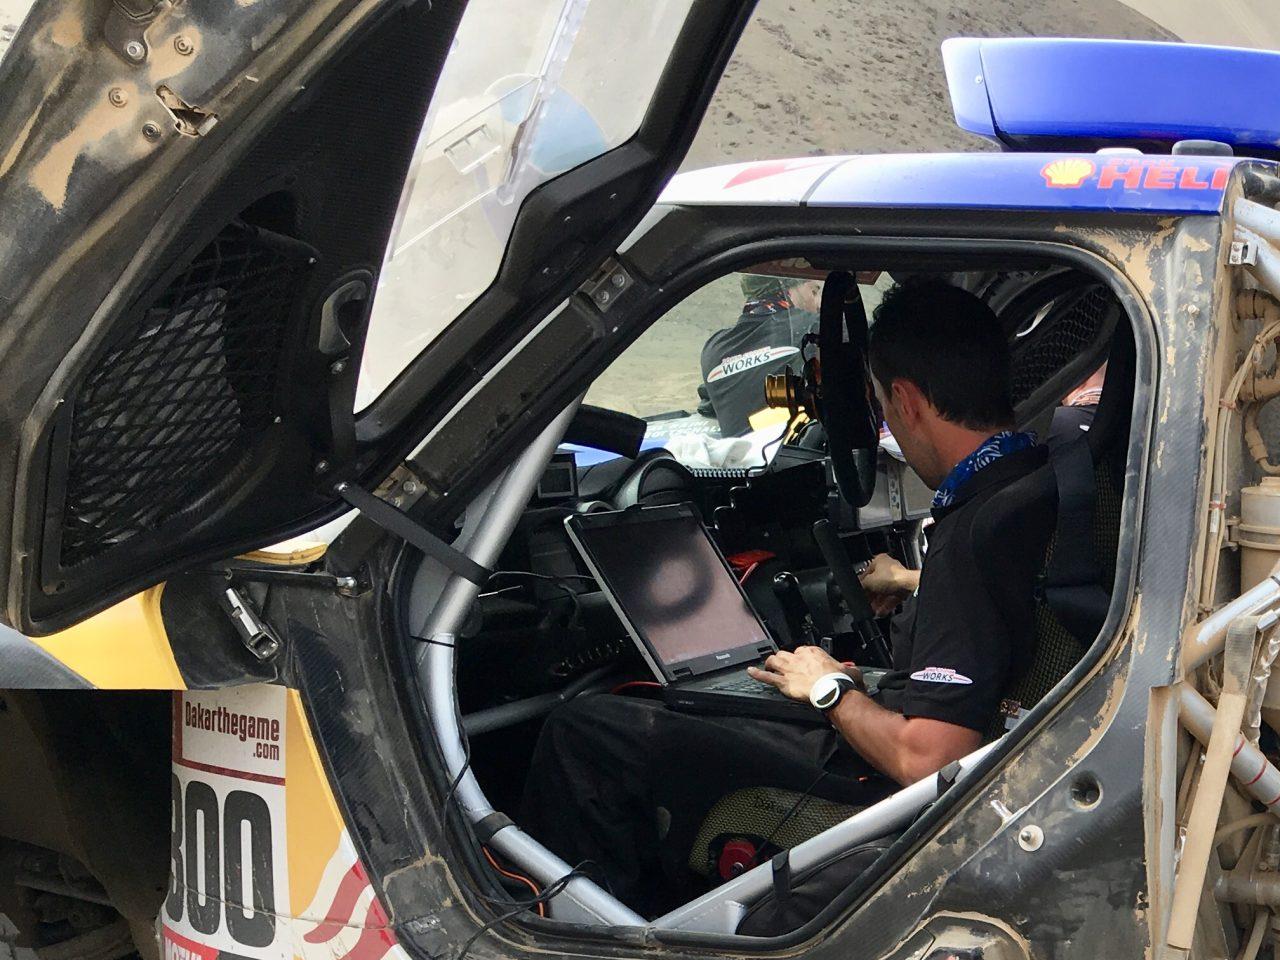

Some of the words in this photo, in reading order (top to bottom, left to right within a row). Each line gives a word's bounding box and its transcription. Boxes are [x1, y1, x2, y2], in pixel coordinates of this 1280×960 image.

[722, 351, 770, 375] WORKS
[922, 672, 953, 682] WORKS
[185, 701, 280, 742] Dakarthegame
[252, 742, 280, 761] .com
